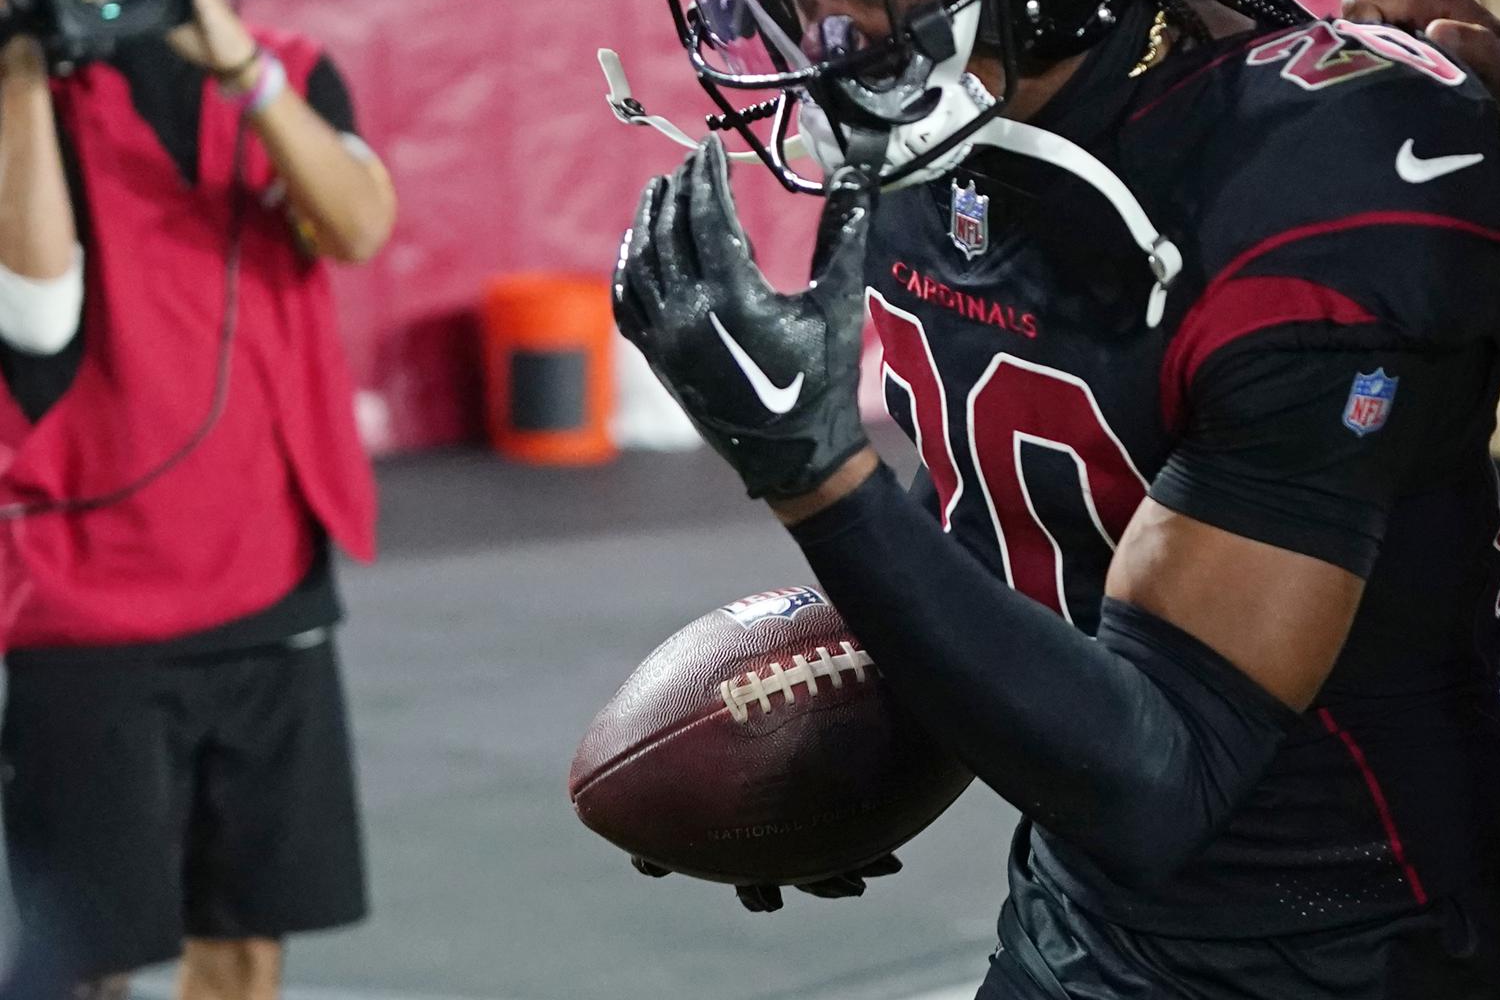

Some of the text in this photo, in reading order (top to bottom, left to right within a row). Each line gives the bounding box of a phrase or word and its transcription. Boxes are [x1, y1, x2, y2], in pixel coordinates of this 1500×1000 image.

[1246, 18, 1467, 91] 20
[956, 214, 984, 248] NFL
[891, 261, 1038, 339] CARDINALS
[1350, 397, 1386, 427] NFL
